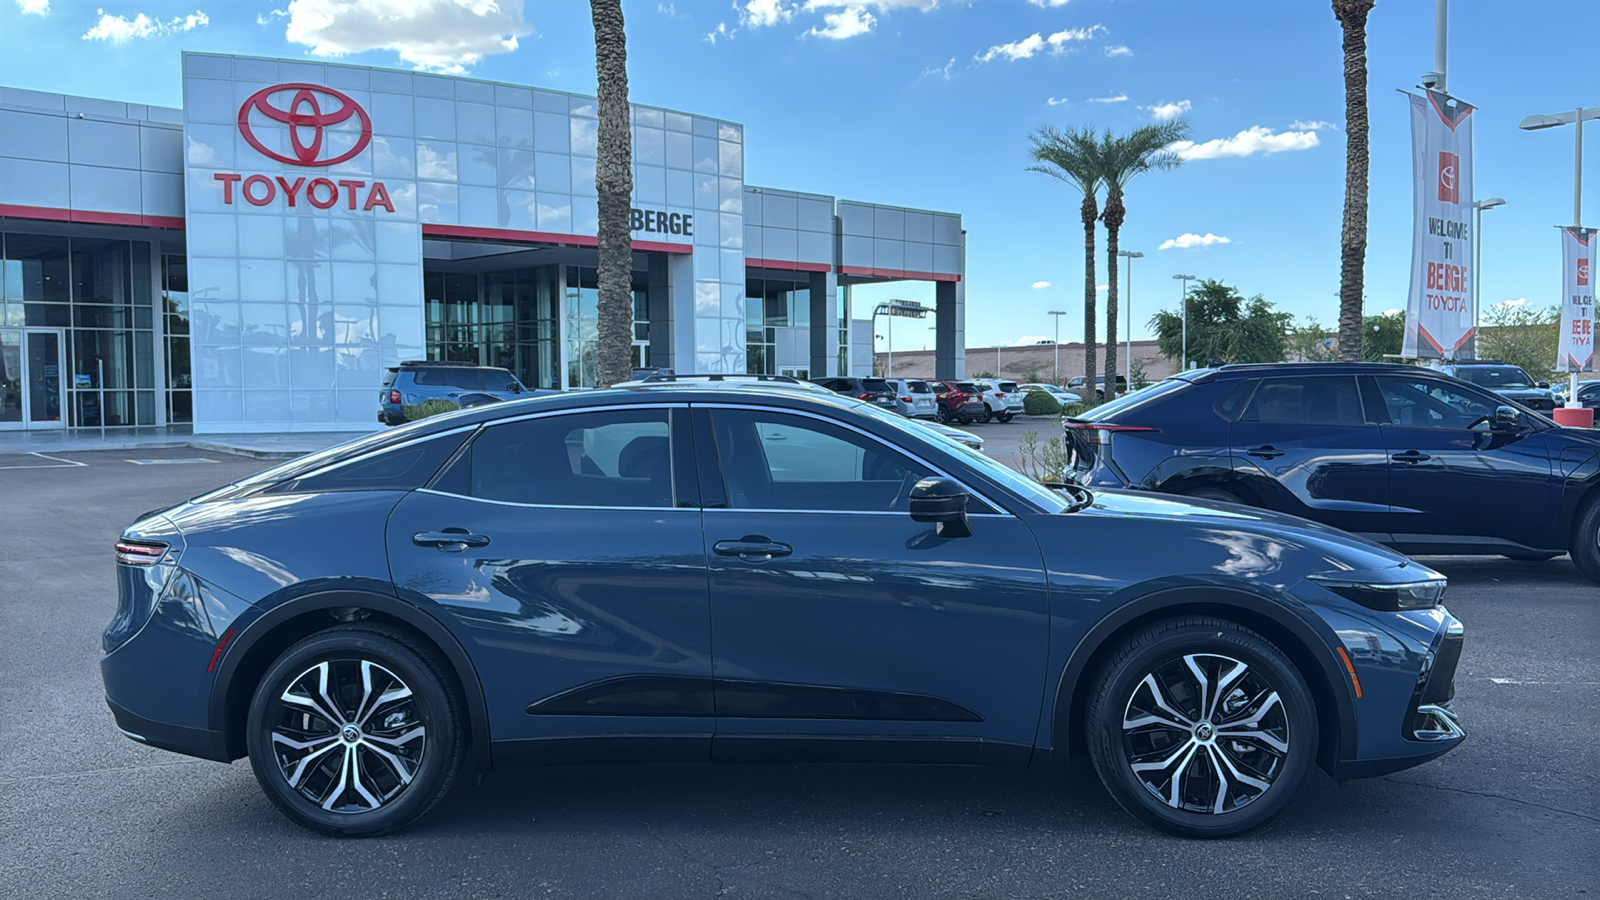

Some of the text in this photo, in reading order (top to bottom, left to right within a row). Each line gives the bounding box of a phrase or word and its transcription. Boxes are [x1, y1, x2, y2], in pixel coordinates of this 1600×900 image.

[214, 173, 395, 212] TOYOTA
[631, 208, 693, 236] BERGE
[1426, 294, 1467, 313] TOYOTA
